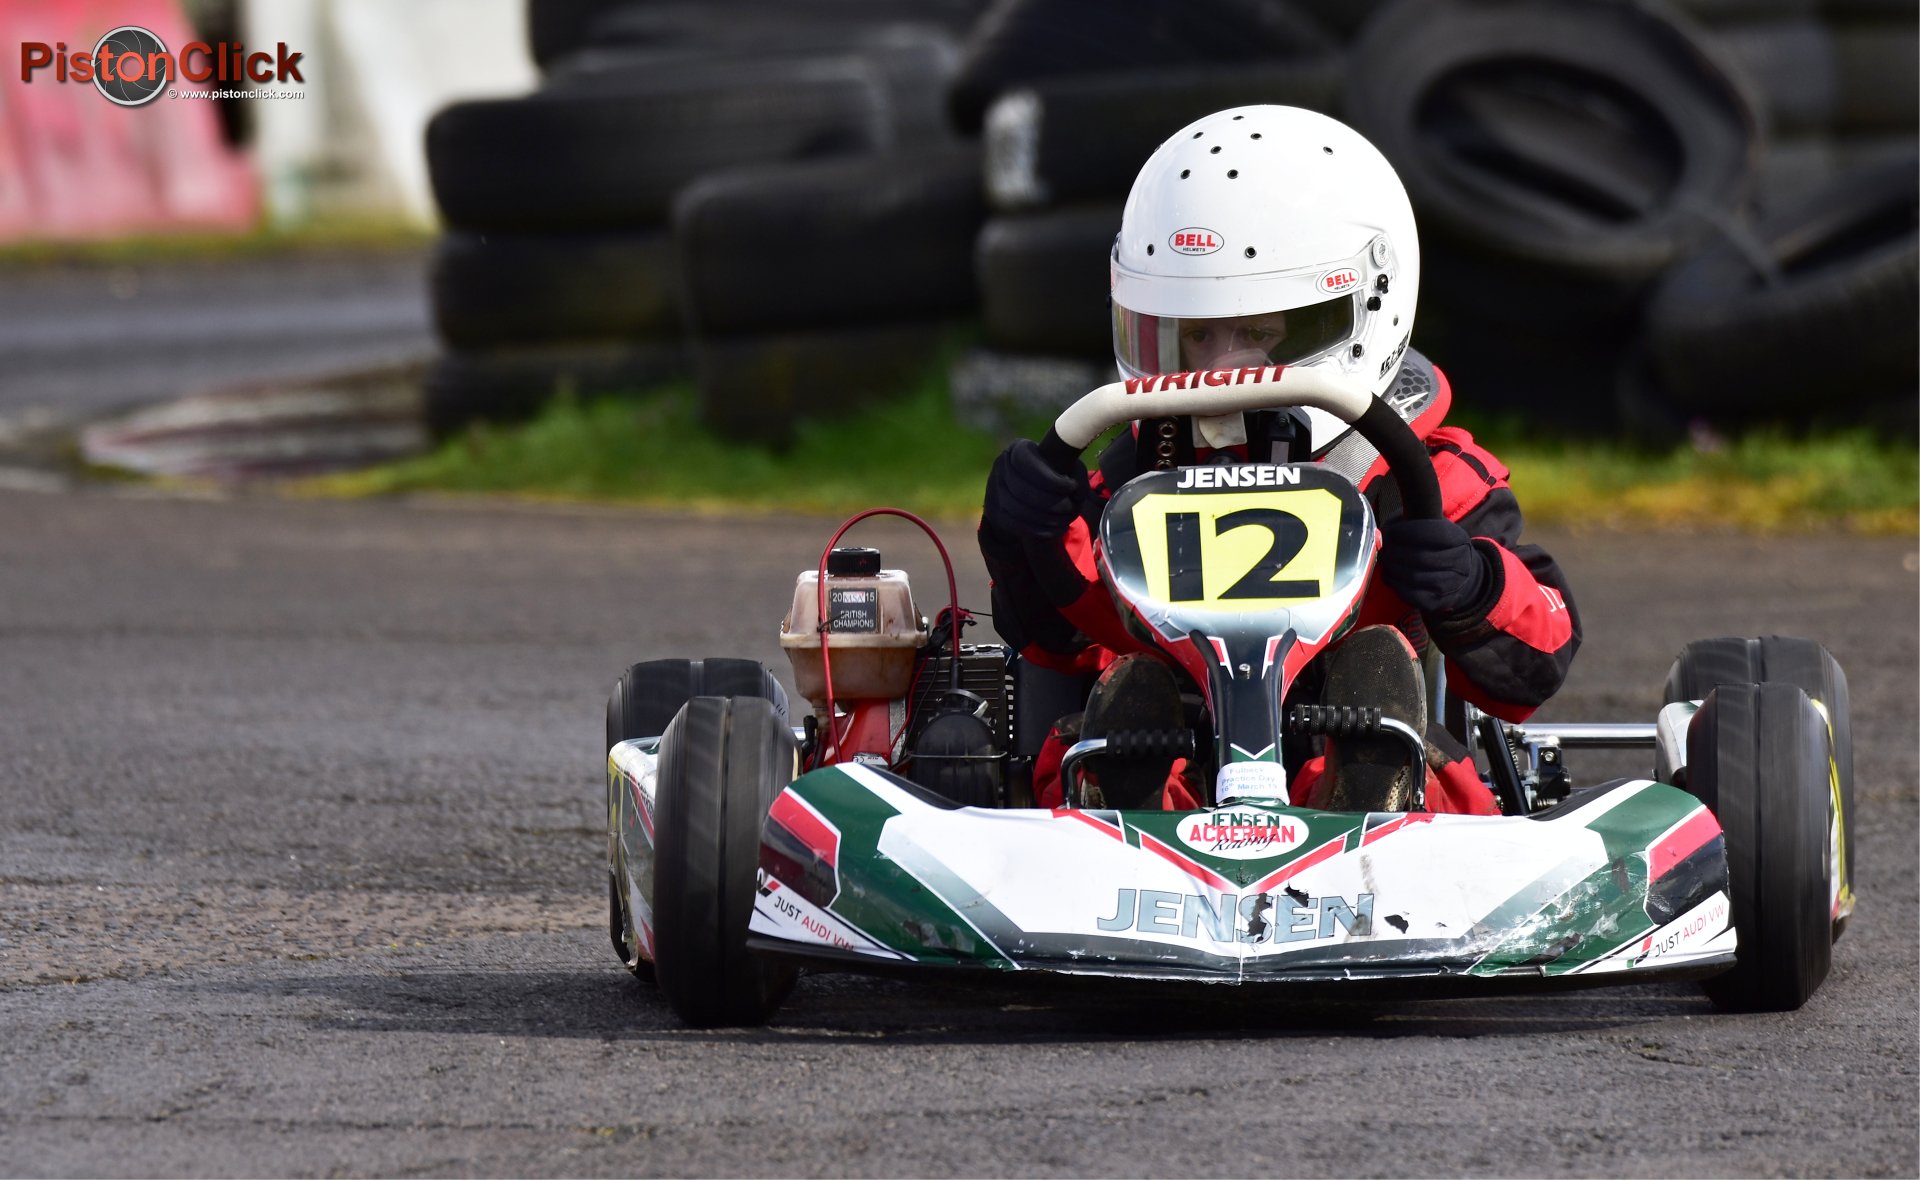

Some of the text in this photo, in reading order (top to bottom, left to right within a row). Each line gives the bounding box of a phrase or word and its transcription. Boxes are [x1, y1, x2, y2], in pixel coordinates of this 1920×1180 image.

[1175, 233, 1216, 247] BELL
[1326, 271, 1357, 288] BELL
[1125, 363, 1293, 395] WRIGHT
[1176, 465, 1300, 489] JENSEN
[1165, 507, 1320, 603] 12
[833, 619, 874, 629] CHAMPIONS
[840, 610, 867, 619] BRITISH
[1221, 775, 1257, 786] Practice
[1204, 812, 1280, 829] JENSEN
[1189, 824, 1295, 843] ACKERMAN
[1208, 833, 1277, 852] Racing
[774, 895, 802, 921] JUST
[801, 915, 832, 941] AUDI
[1097, 888, 1374, 944] JENSEN
[1655, 902, 1725, 958] JUST AUDI VW
